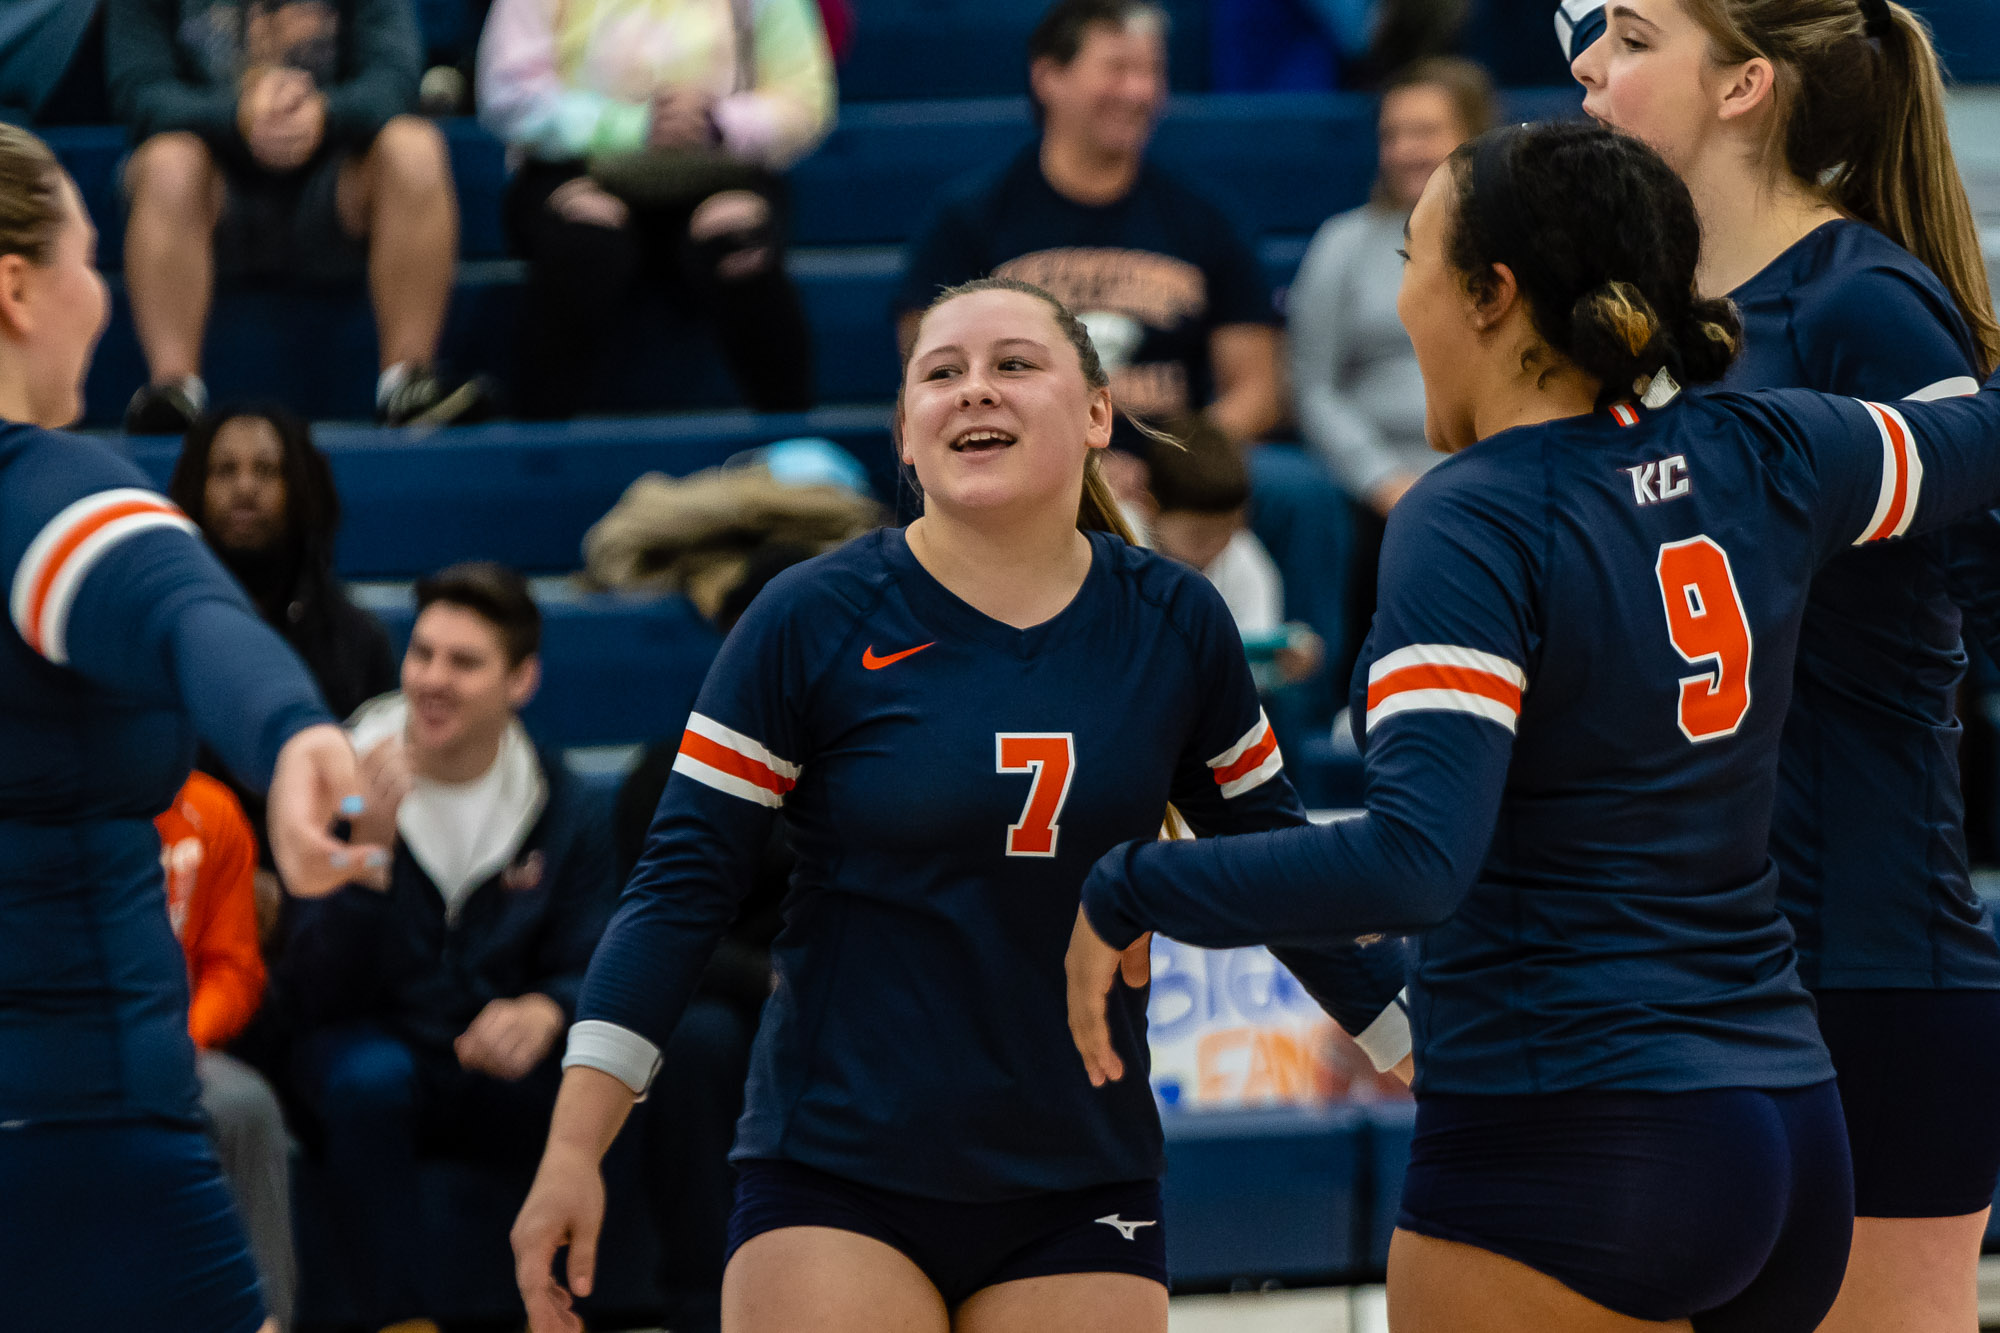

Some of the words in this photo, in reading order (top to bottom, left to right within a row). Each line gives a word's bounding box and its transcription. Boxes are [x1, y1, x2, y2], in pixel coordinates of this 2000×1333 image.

[1622, 454, 1692, 506] KC
[1655, 534, 1753, 744] 9
[995, 732, 1076, 858] 7
